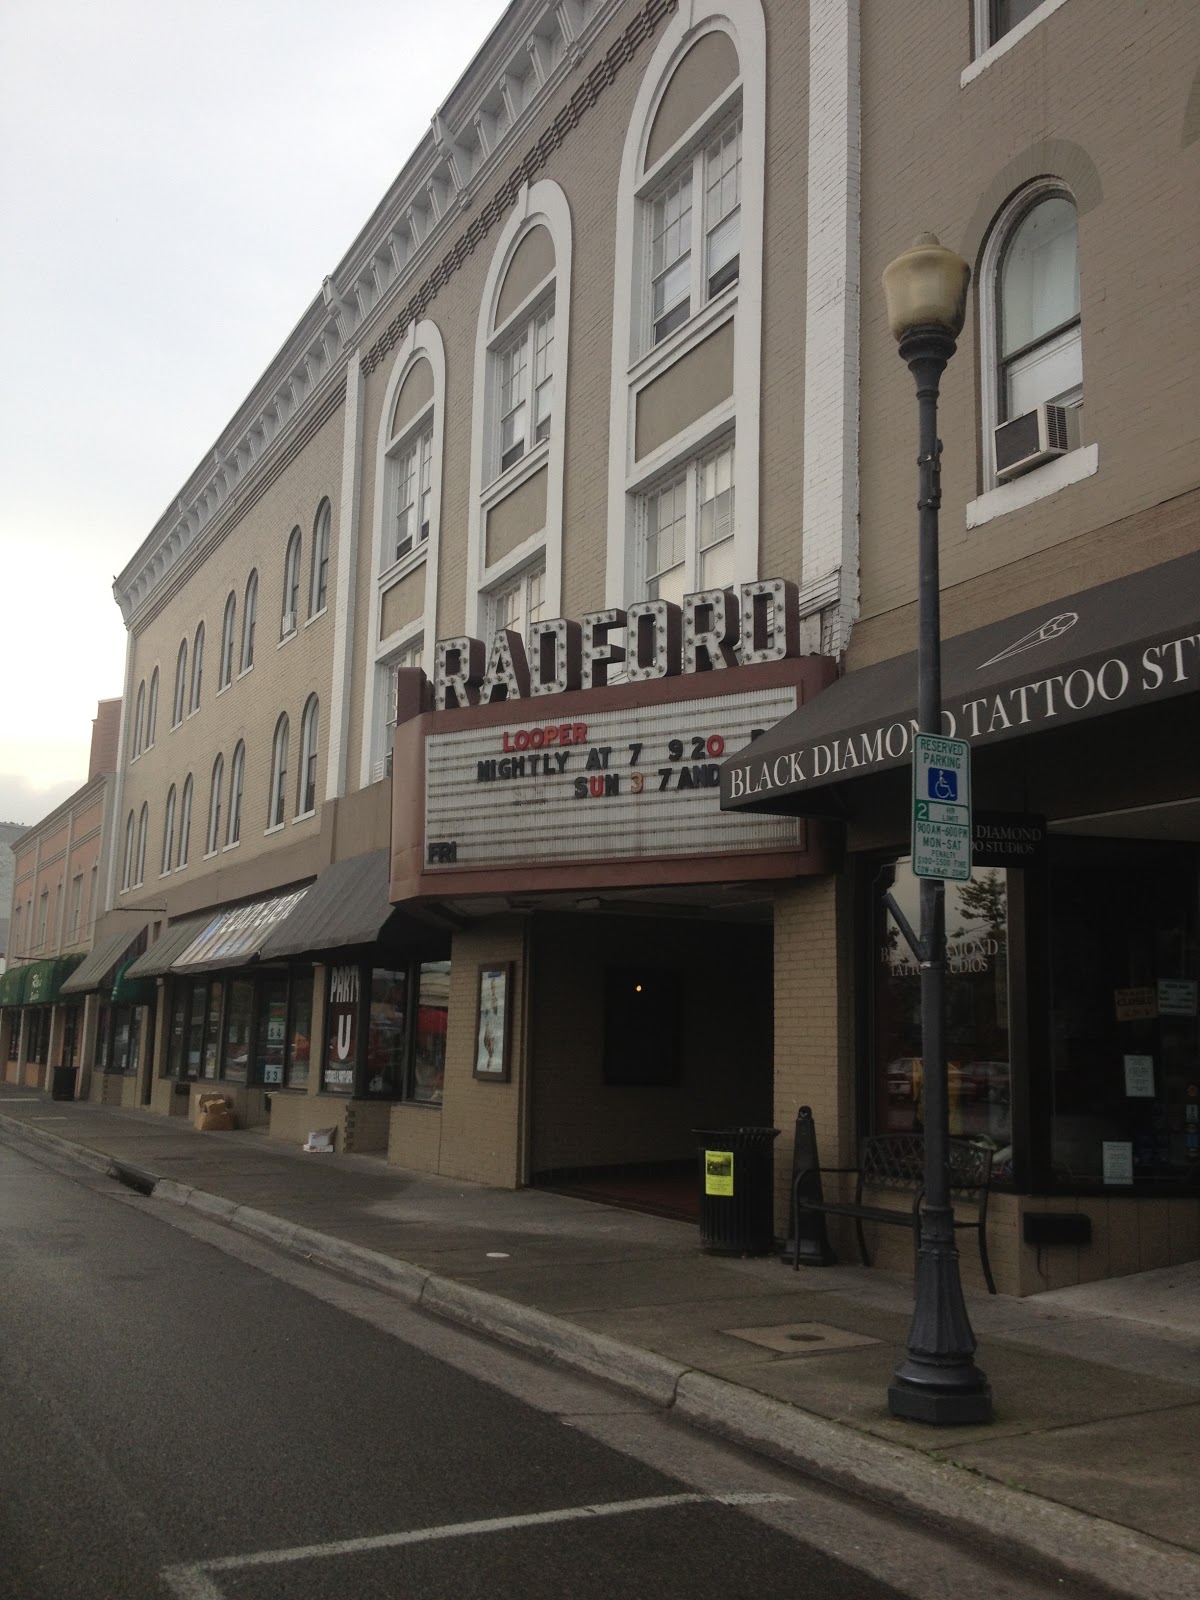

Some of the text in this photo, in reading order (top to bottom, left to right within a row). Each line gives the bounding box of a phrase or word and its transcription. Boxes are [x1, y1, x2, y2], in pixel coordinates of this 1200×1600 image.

[435, 577, 799, 712] RADFORD
[729, 749, 807, 800] BLACK
[962, 658, 1129, 738] TATTOO
[1142, 633, 1200, 690] ST
[503, 722, 588, 753] LOOPER
[920, 738, 964, 756] RESERVED
[477, 751, 570, 782] NIGHTLY
[585, 746, 612, 770] AT
[629, 743, 643, 766] 7
[923, 752, 961, 769] PARKING
[574, 774, 620, 799] SUN
[631, 772, 645, 794] 3
[917, 803, 927, 819] 2
[942, 815, 959, 823] LIMIT
[976, 826, 1042, 841] DIAMOND
[922, 837, 962, 850] MON-SAT
[986, 841, 1036, 855] STUDIOS
[428, 841, 458, 864] FRI
[931, 849, 957, 859] PENALTY
[946, 957, 989, 974] UDIOS
[337, 1014, 352, 1060] U
